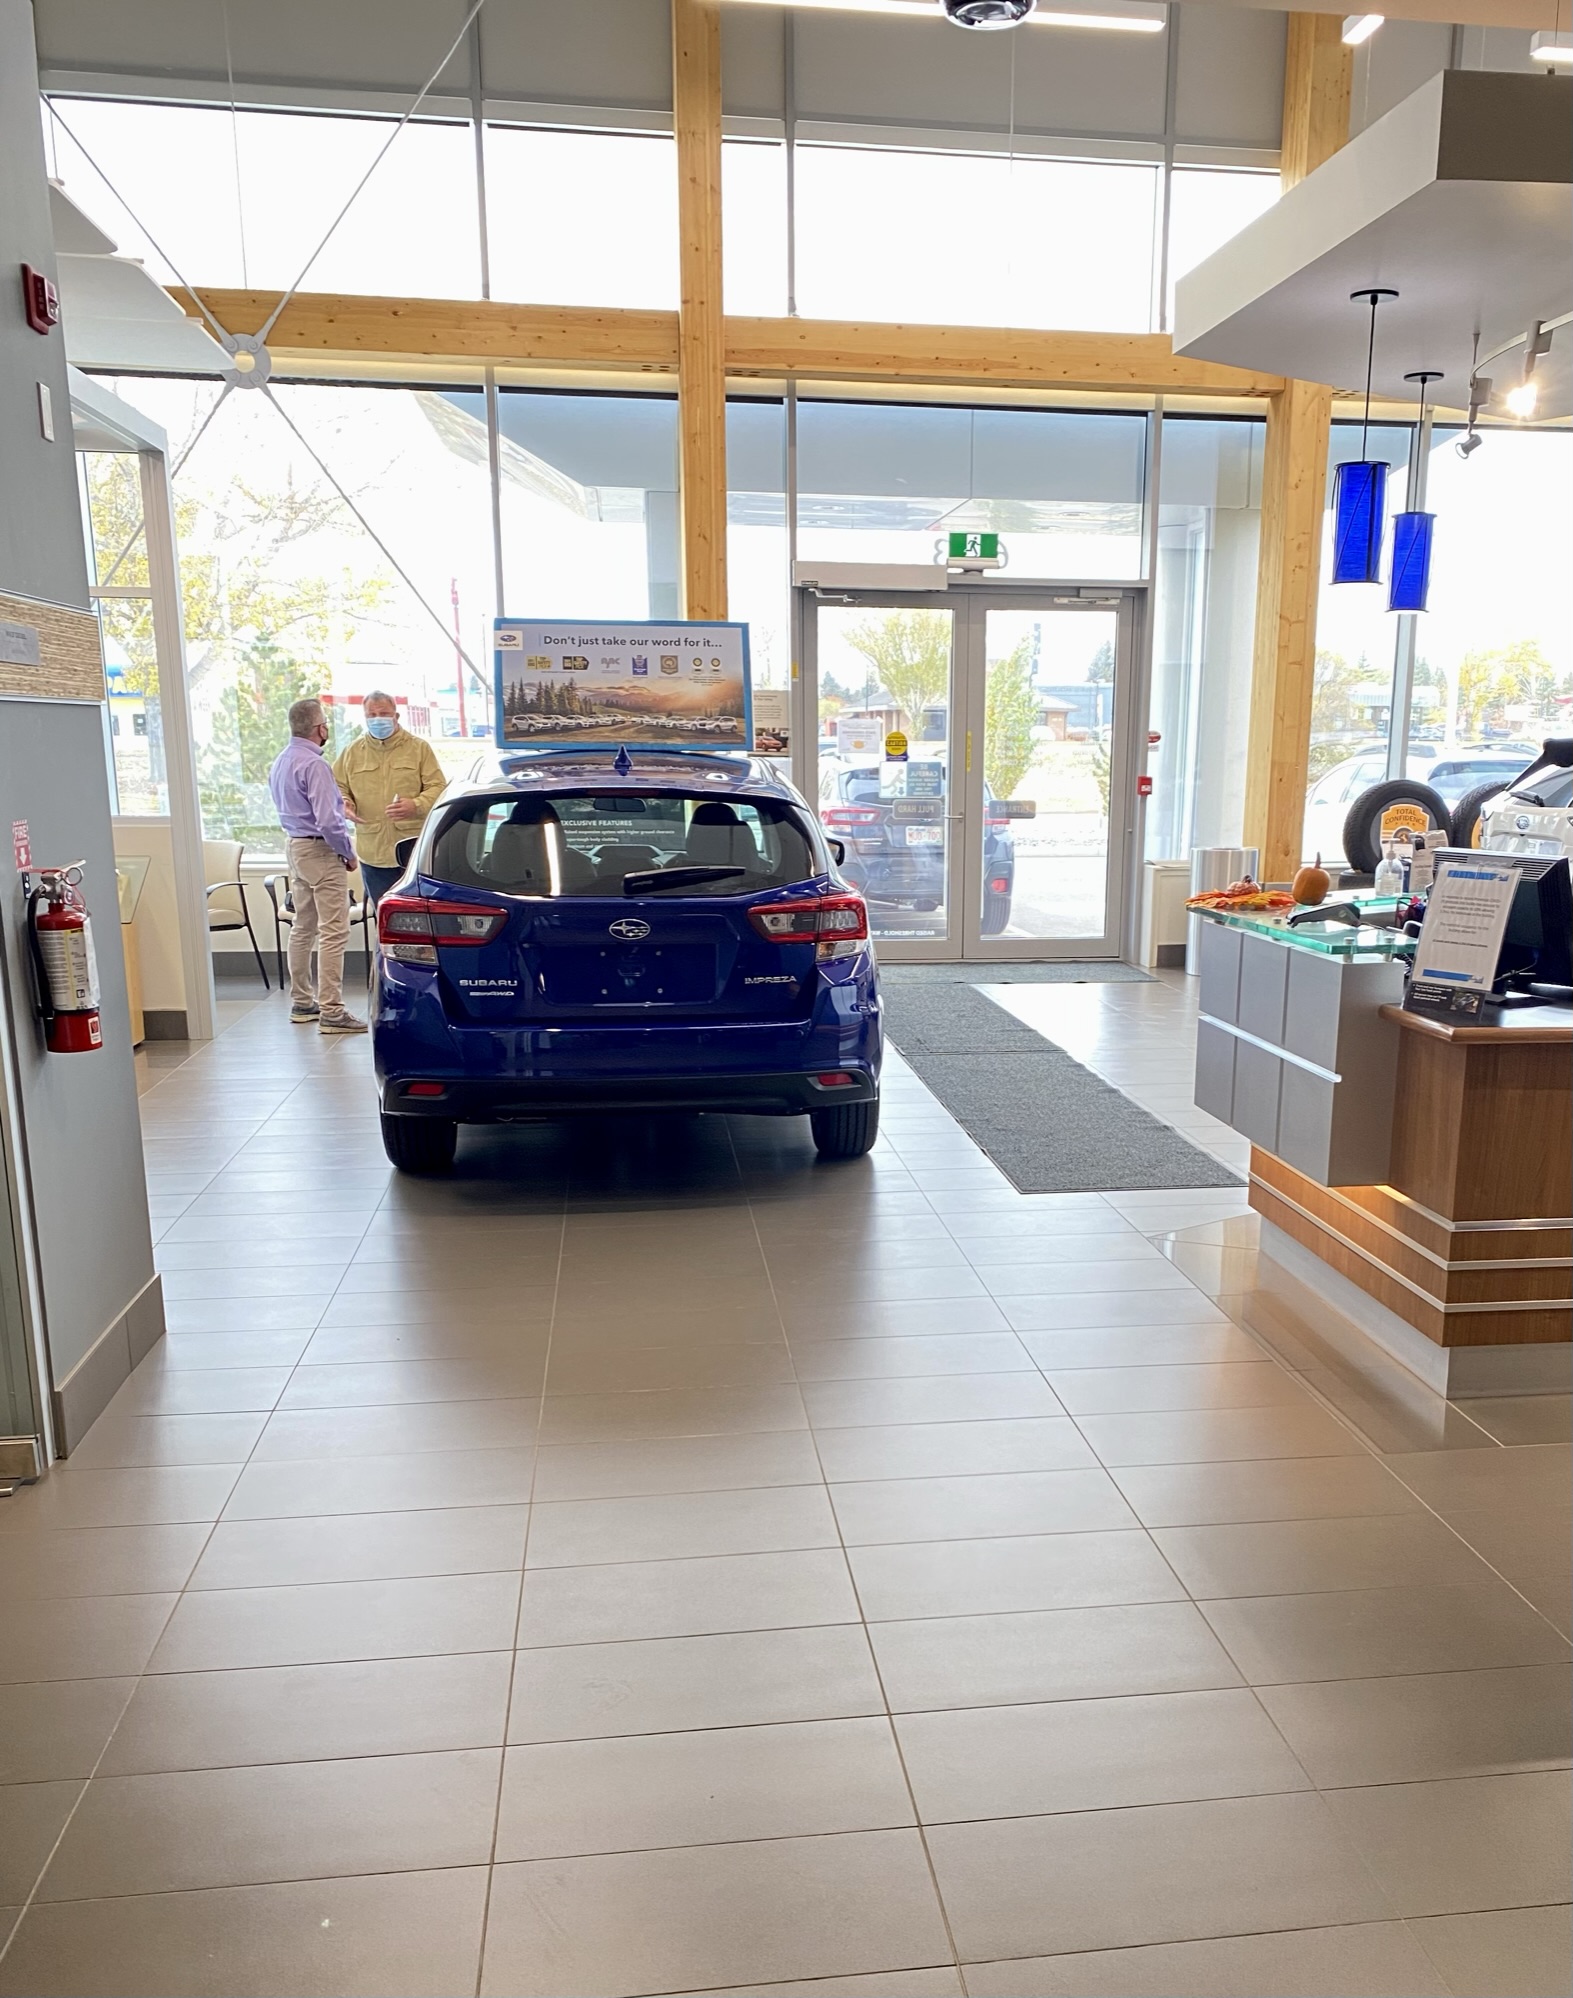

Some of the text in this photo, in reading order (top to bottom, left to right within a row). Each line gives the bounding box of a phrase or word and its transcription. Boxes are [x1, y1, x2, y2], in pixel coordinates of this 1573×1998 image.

[543, 635, 576, 645] Don't
[578, 636, 599, 647] just
[602, 636, 627, 646] take
[651, 637, 681, 647] word
[684, 637, 700, 647] for
[1396, 808, 1417, 816] TOTAL
[1384, 815, 1426, 826] CONFIDENCE
[744, 975, 798, 984] IMPREZA
